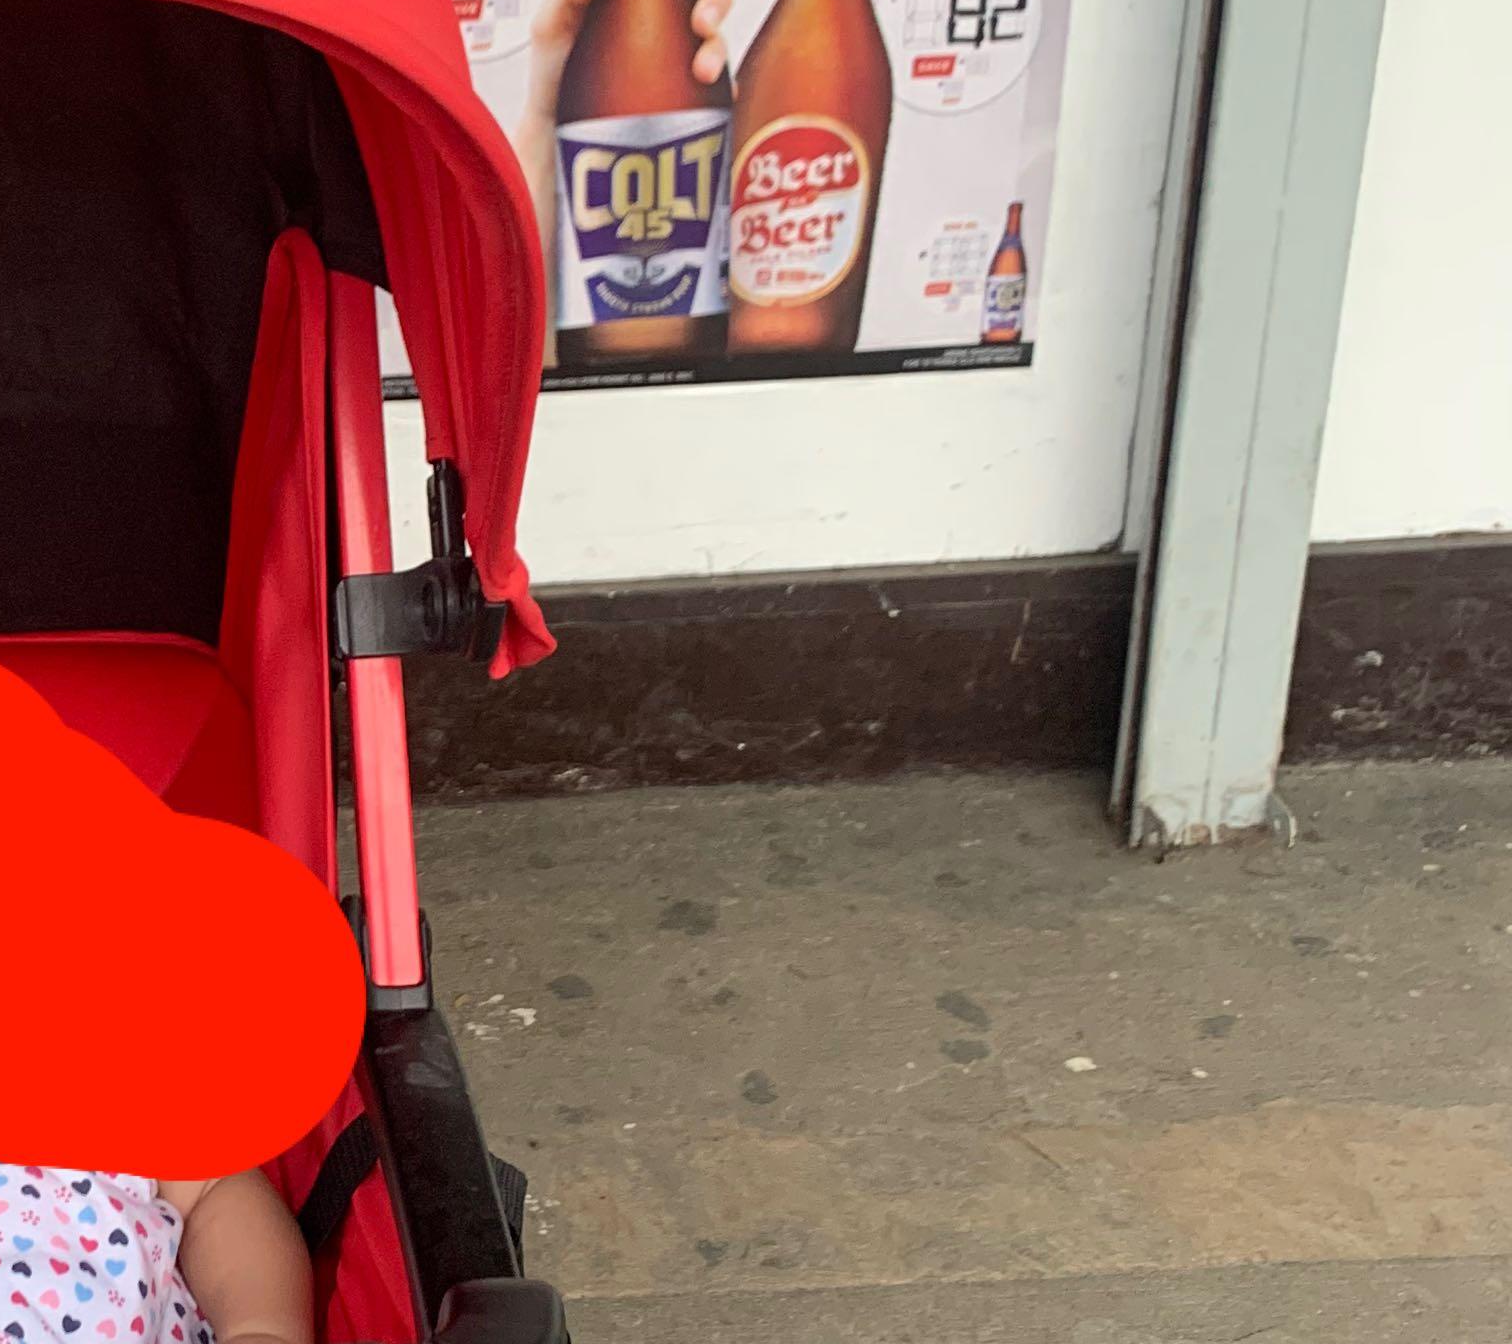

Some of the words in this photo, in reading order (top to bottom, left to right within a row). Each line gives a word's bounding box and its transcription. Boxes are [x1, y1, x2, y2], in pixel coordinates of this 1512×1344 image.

[572, 132, 725, 233] COLT
[742, 149, 855, 200] Beer
[616, 205, 676, 243] 45
[737, 210, 846, 253] Beer
